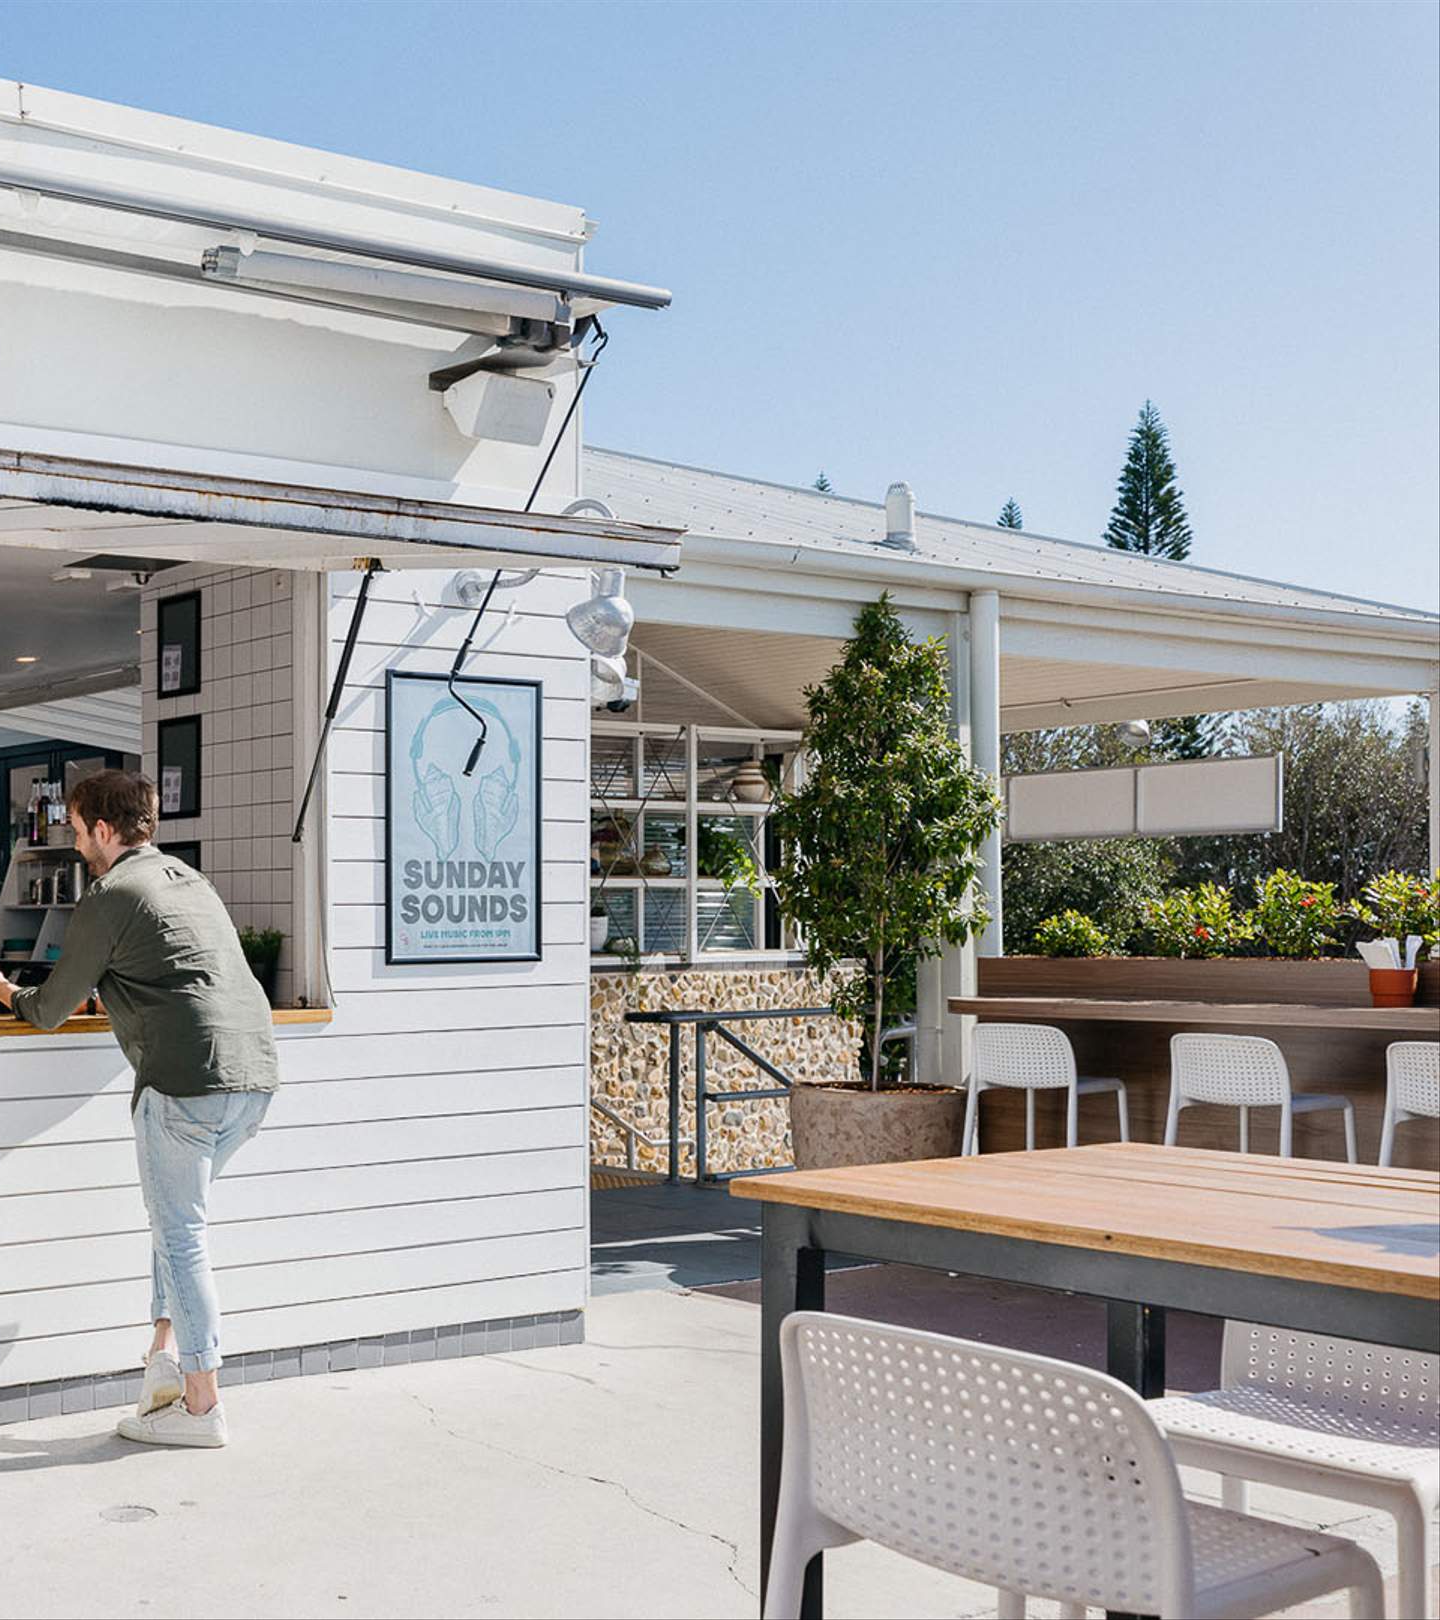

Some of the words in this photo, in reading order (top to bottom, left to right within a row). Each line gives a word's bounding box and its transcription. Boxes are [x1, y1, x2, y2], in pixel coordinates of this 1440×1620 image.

[403, 859, 526, 890] SUNDAY
[400, 893, 528, 924] SOUNDS
[420, 930, 439, 939] LIVE
[441, 930, 468, 938] MUSIC
[469, 929, 494, 938] FROM
